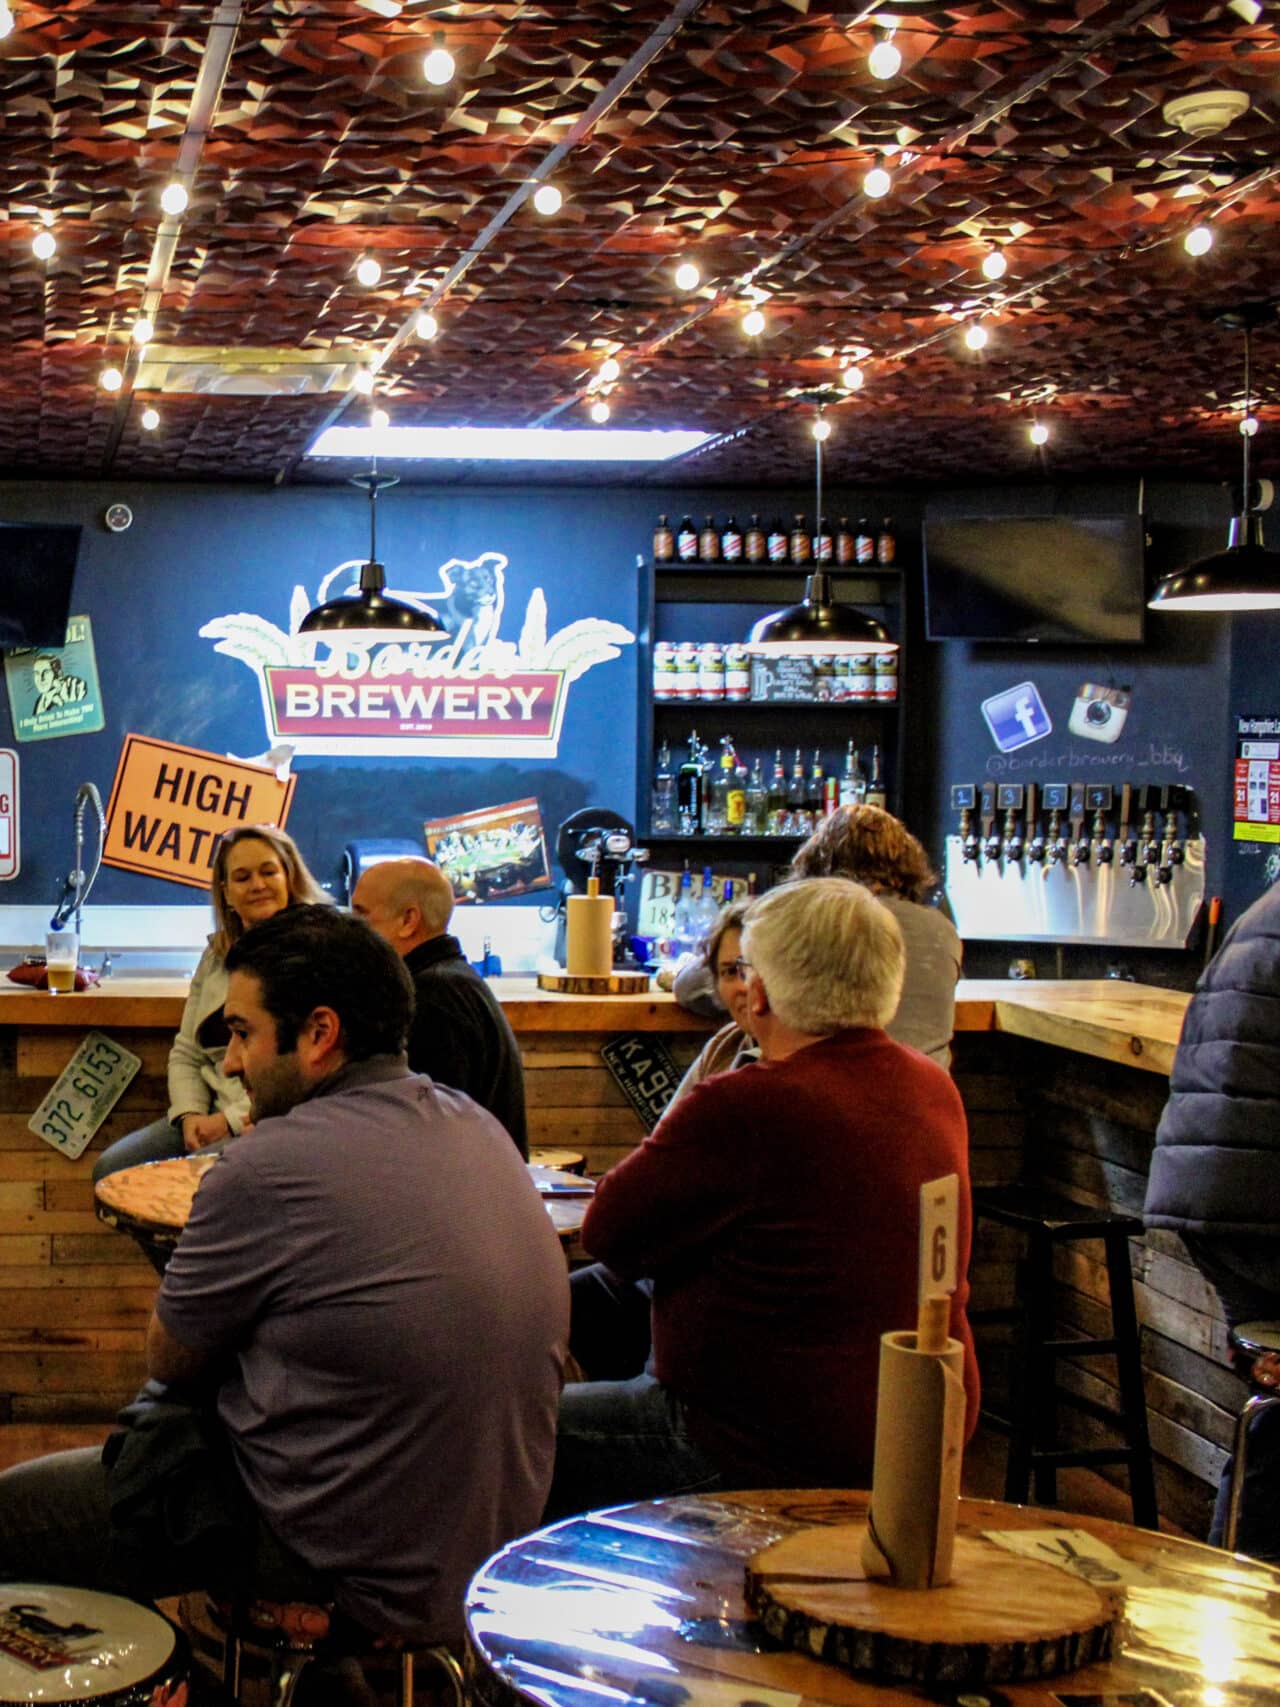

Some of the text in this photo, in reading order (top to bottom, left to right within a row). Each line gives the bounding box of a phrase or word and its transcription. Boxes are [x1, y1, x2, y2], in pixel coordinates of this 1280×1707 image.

[285, 684, 545, 720] BREWERY
[153, 763, 253, 820] HIGH
[1004, 789, 1015, 804] 3
[1050, 790, 1059, 805] 5
[42, 1042, 121, 1144] 372 6153
[932, 1224, 947, 1282] 6
